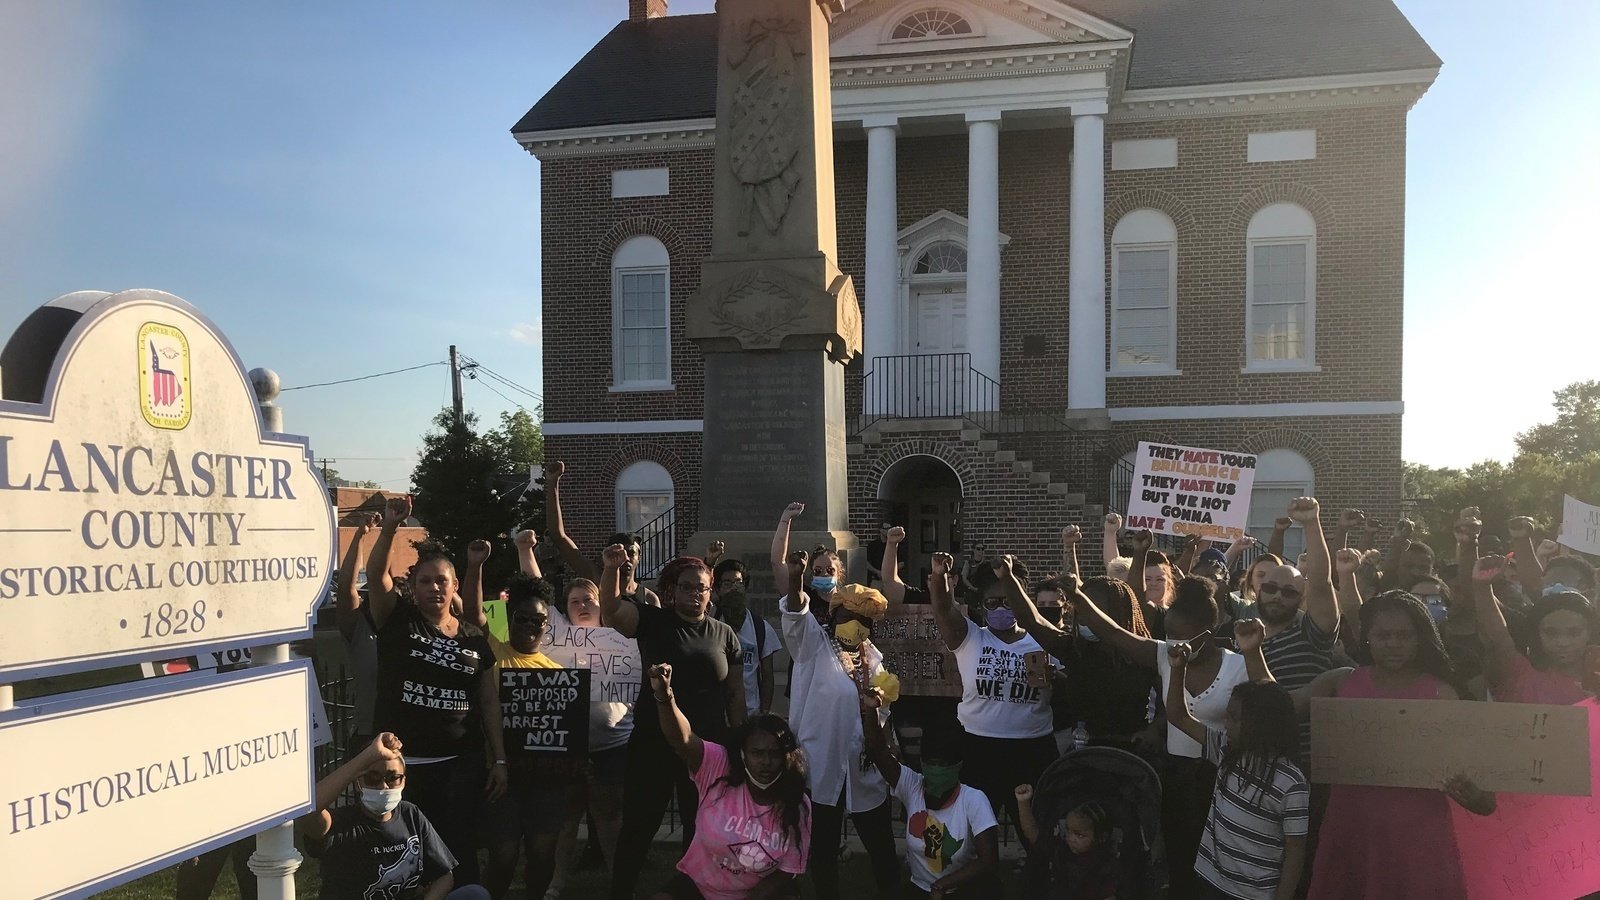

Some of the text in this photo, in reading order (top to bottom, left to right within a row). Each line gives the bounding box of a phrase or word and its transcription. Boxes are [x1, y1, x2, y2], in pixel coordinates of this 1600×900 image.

[0, 435, 296, 500] LANCASTER
[1148, 445, 1257, 469] THEY HATE YOUR
[1151, 459, 1241, 481] BRILLIANCE
[1142, 474, 1236, 495] THEY HATE US
[1141, 489, 1231, 511] BUT WE NOT
[1128, 515, 1165, 530] HATE
[1161, 505, 1213, 524] GONNA
[81, 509, 246, 550] COUNTY
[168, 556, 319, 588] COURTHOUSE
[140, 599, 207, 639] 1828
[409, 632, 481, 660] JUSTICE
[434, 636, 459, 647] NO
[541, 624, 596, 648] BLACK
[431, 648, 457, 661] NO
[982, 646, 998, 655] WE
[409, 649, 476, 676] PEACE
[979, 657, 993, 665] WE
[995, 658, 1011, 667] SIT
[502, 670, 579, 687] IT WAS
[976, 667, 992, 676] WE
[993, 668, 1028, 679] SPEAK
[402, 680, 467, 700] SAY HIS
[511, 687, 578, 702] SUPPOSED
[600, 681, 642, 703] MATTE
[975, 679, 1041, 701] WE DIE
[501, 700, 566, 714] TO BE AN
[502, 715, 563, 729] ARREST
[526, 730, 570, 747] NOT
[7, 755, 198, 835] HISTORICAL
[202, 727, 299, 779] MUSEUM
